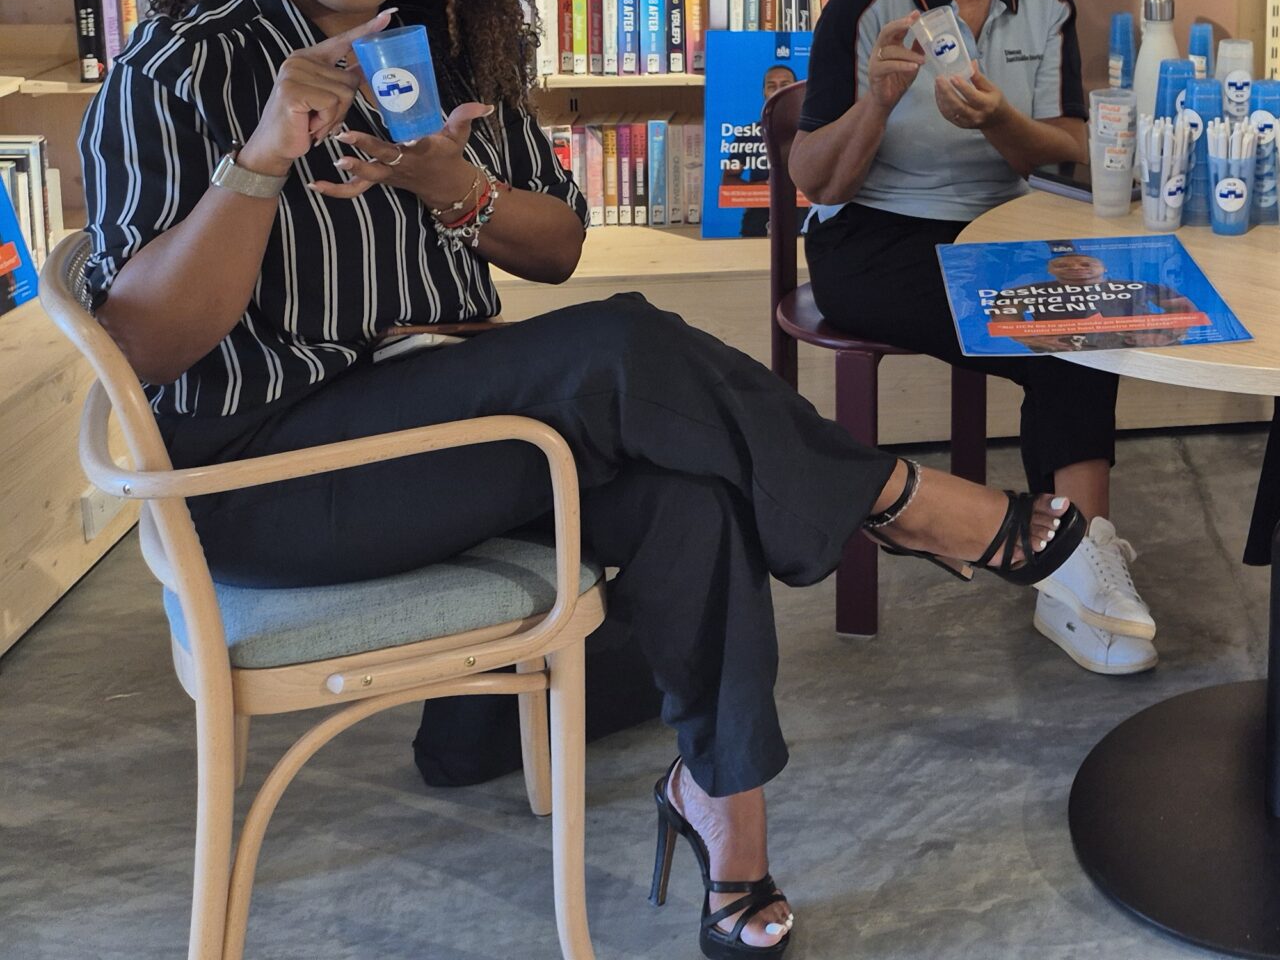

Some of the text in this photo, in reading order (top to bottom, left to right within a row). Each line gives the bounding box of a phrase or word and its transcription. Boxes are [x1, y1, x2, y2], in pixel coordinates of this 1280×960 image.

[623, 6, 633, 31] AFTER
[649, 6, 658, 31] AFTER
[671, 9, 680, 44] VERLIEFD
[721, 122, 762, 137] Desk
[720, 156, 771, 170] na JIC
[1108, 282, 1144, 292] bo
[981, 291, 1132, 306] karera nobo
[983, 305, 1018, 315] na
